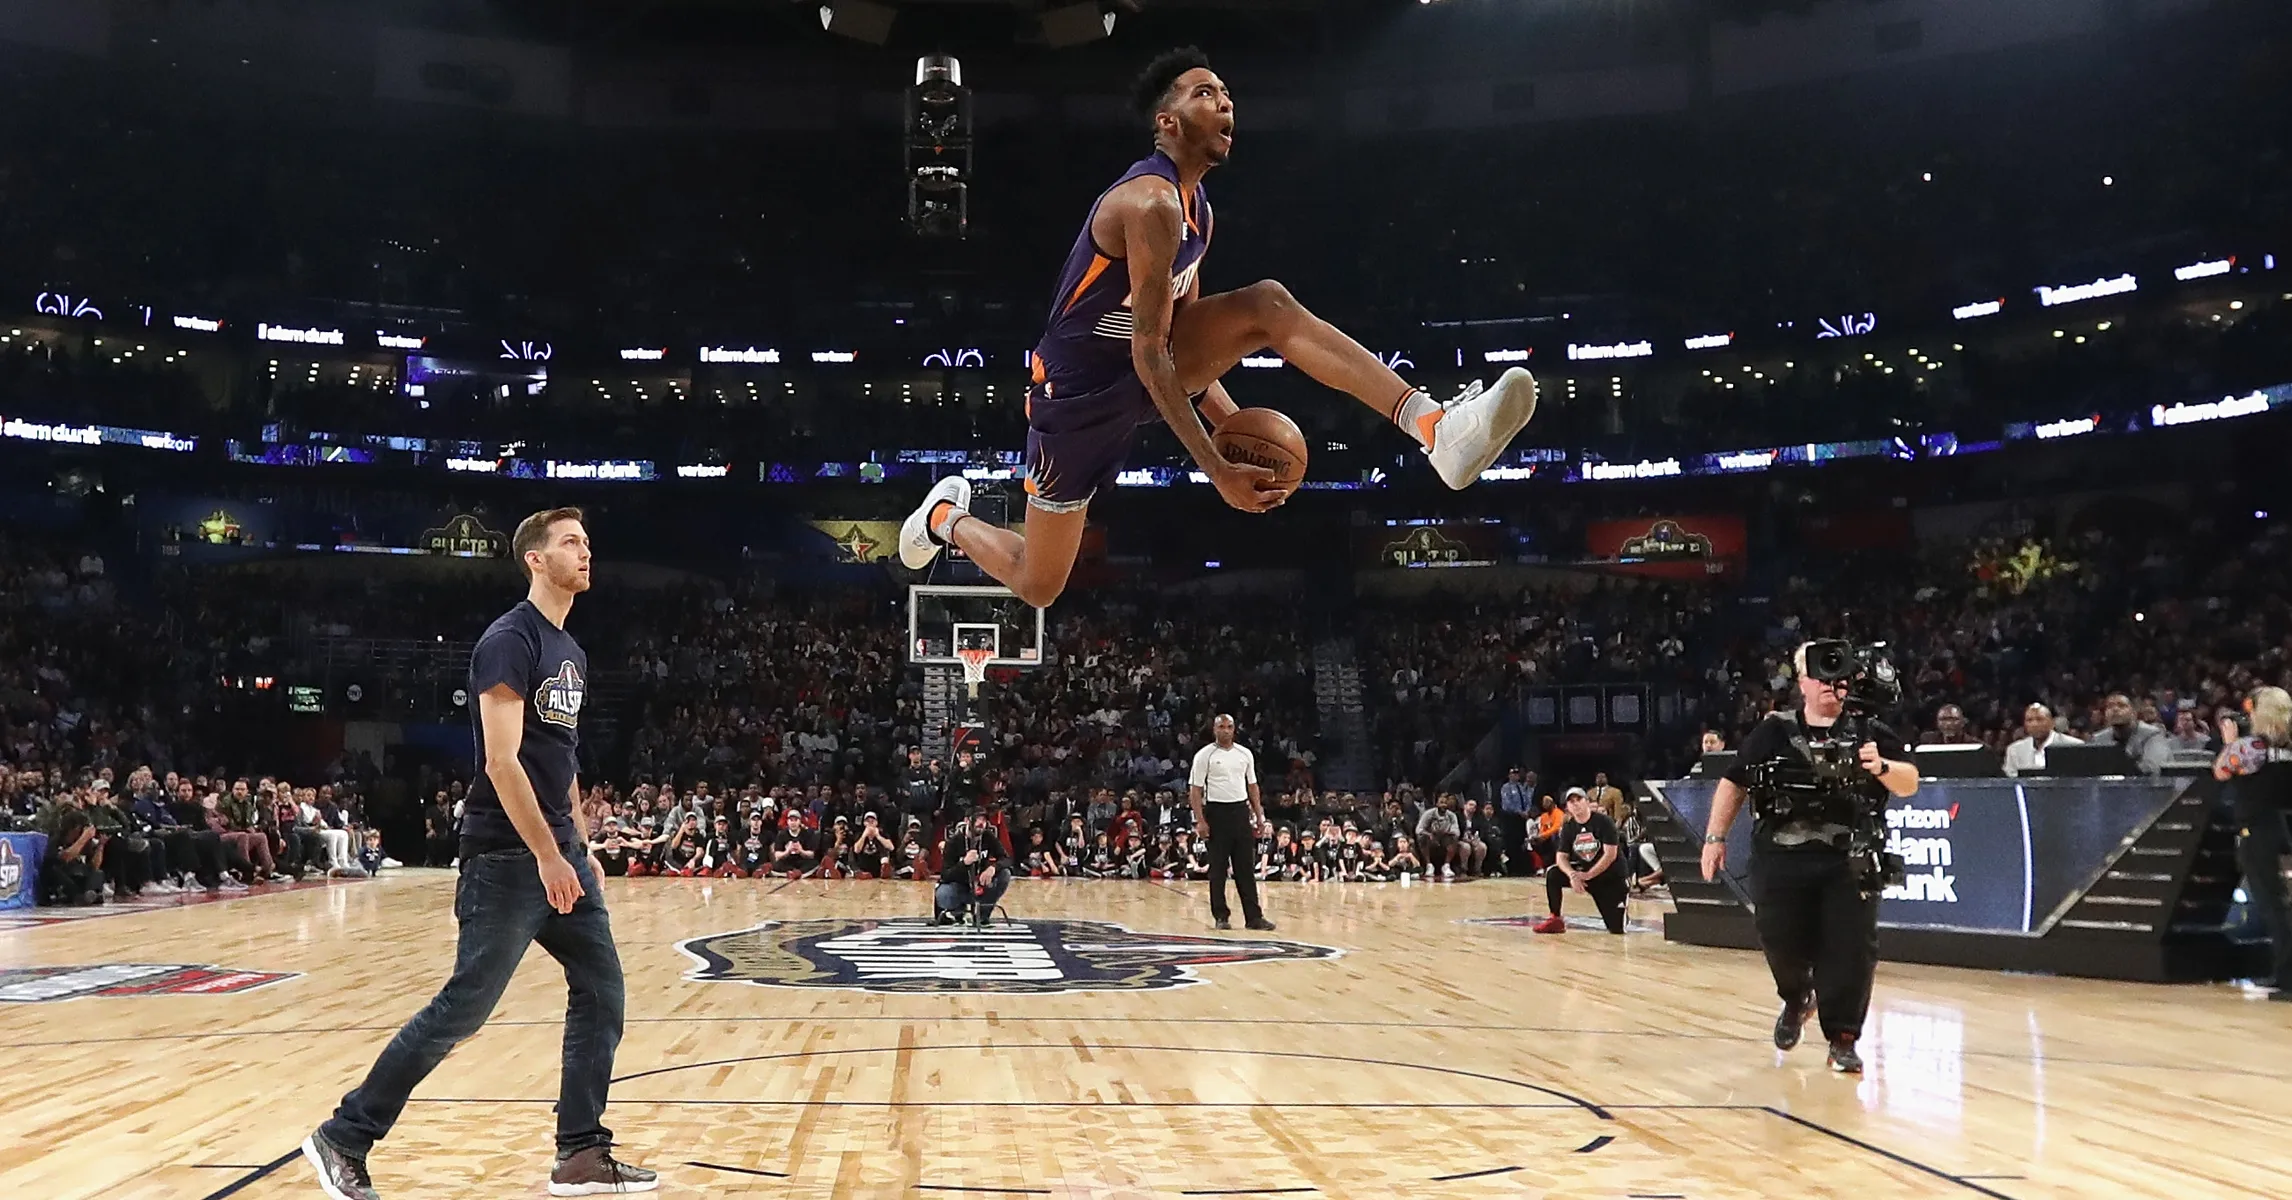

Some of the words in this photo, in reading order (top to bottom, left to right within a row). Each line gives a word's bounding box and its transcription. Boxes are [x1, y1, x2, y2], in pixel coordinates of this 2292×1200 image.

[141, 434, 194, 451] verizon
[446, 455, 497, 471] verizon
[1719, 452, 1772, 469] verizon
[677, 462, 727, 478] verizon
[1117, 469, 1154, 485] unk
[1884, 804, 1950, 829] erizon
